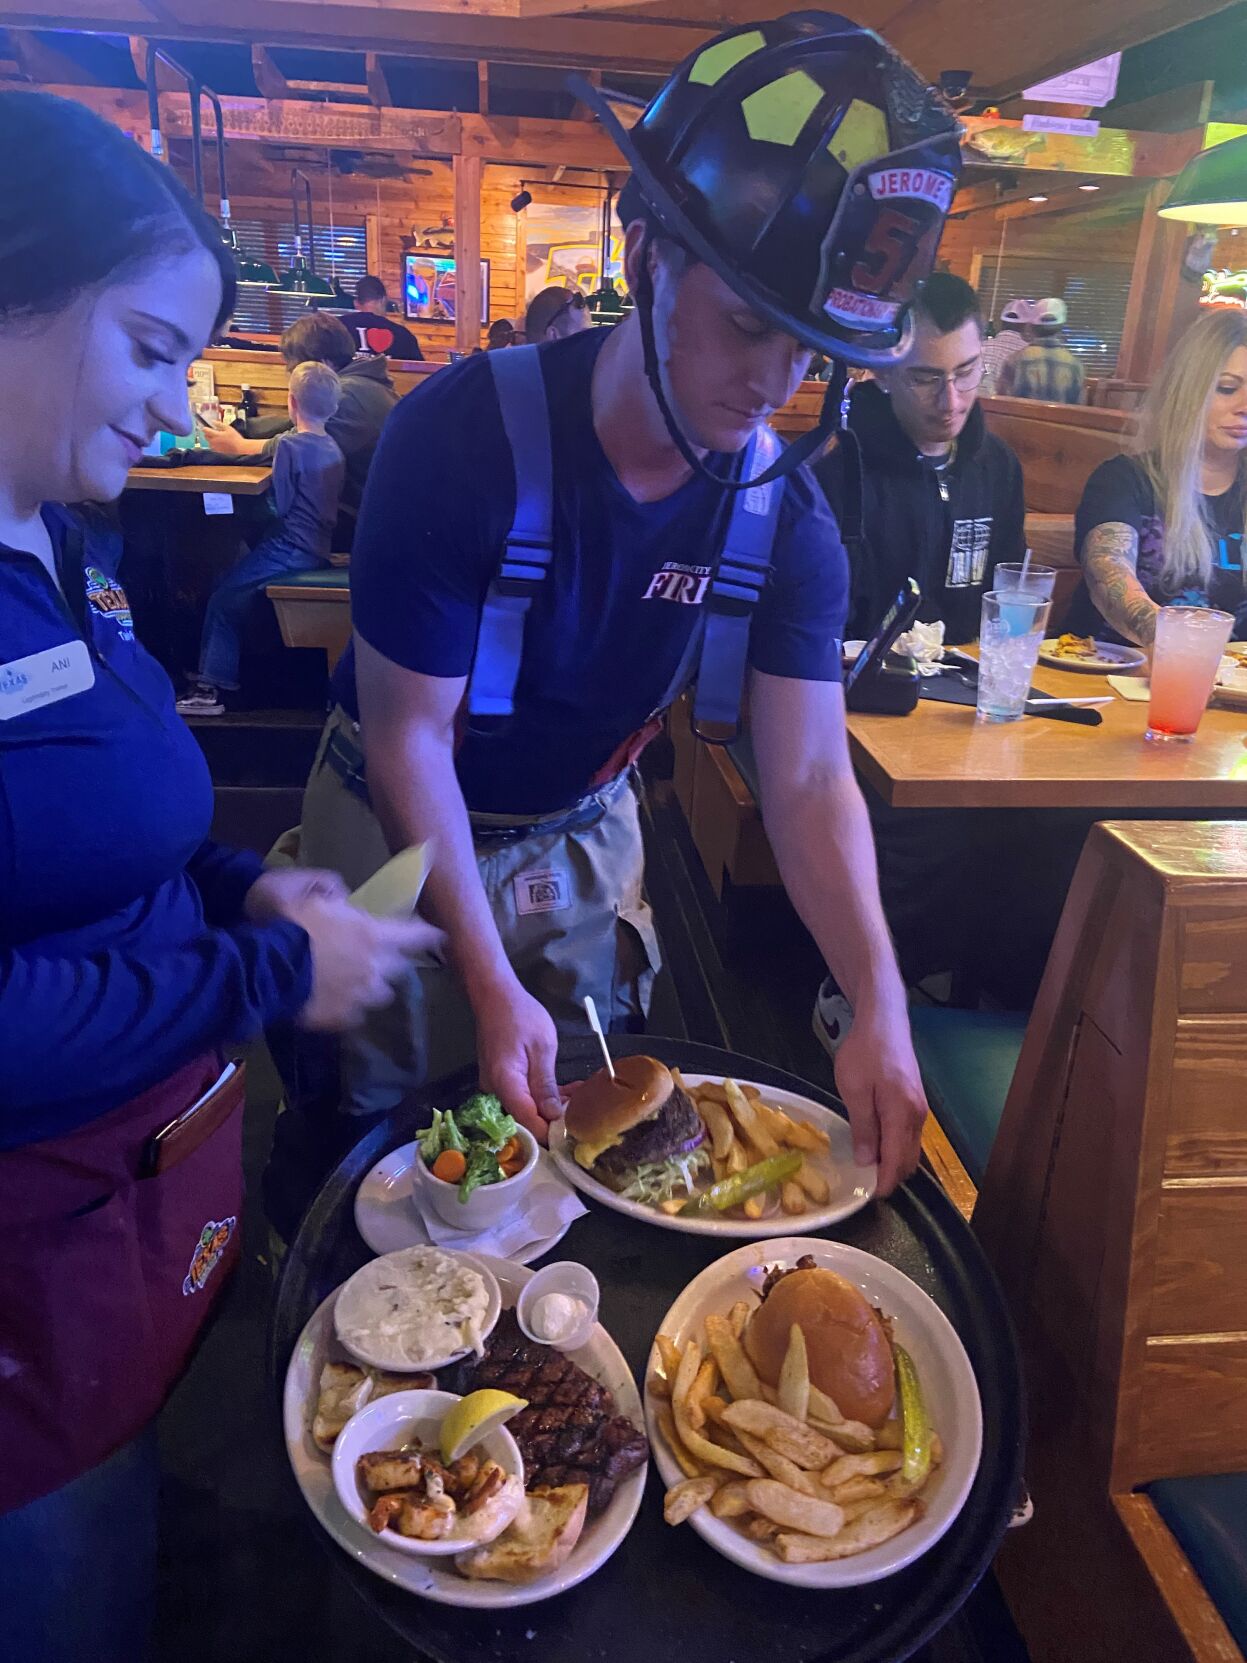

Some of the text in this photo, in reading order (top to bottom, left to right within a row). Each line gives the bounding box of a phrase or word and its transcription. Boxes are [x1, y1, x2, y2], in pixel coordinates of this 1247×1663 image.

[877, 172, 946, 199] JEROME
[355, 327, 370, 351] I
[690, 565, 712, 575] CITY
[51, 657, 71, 673] ANI
